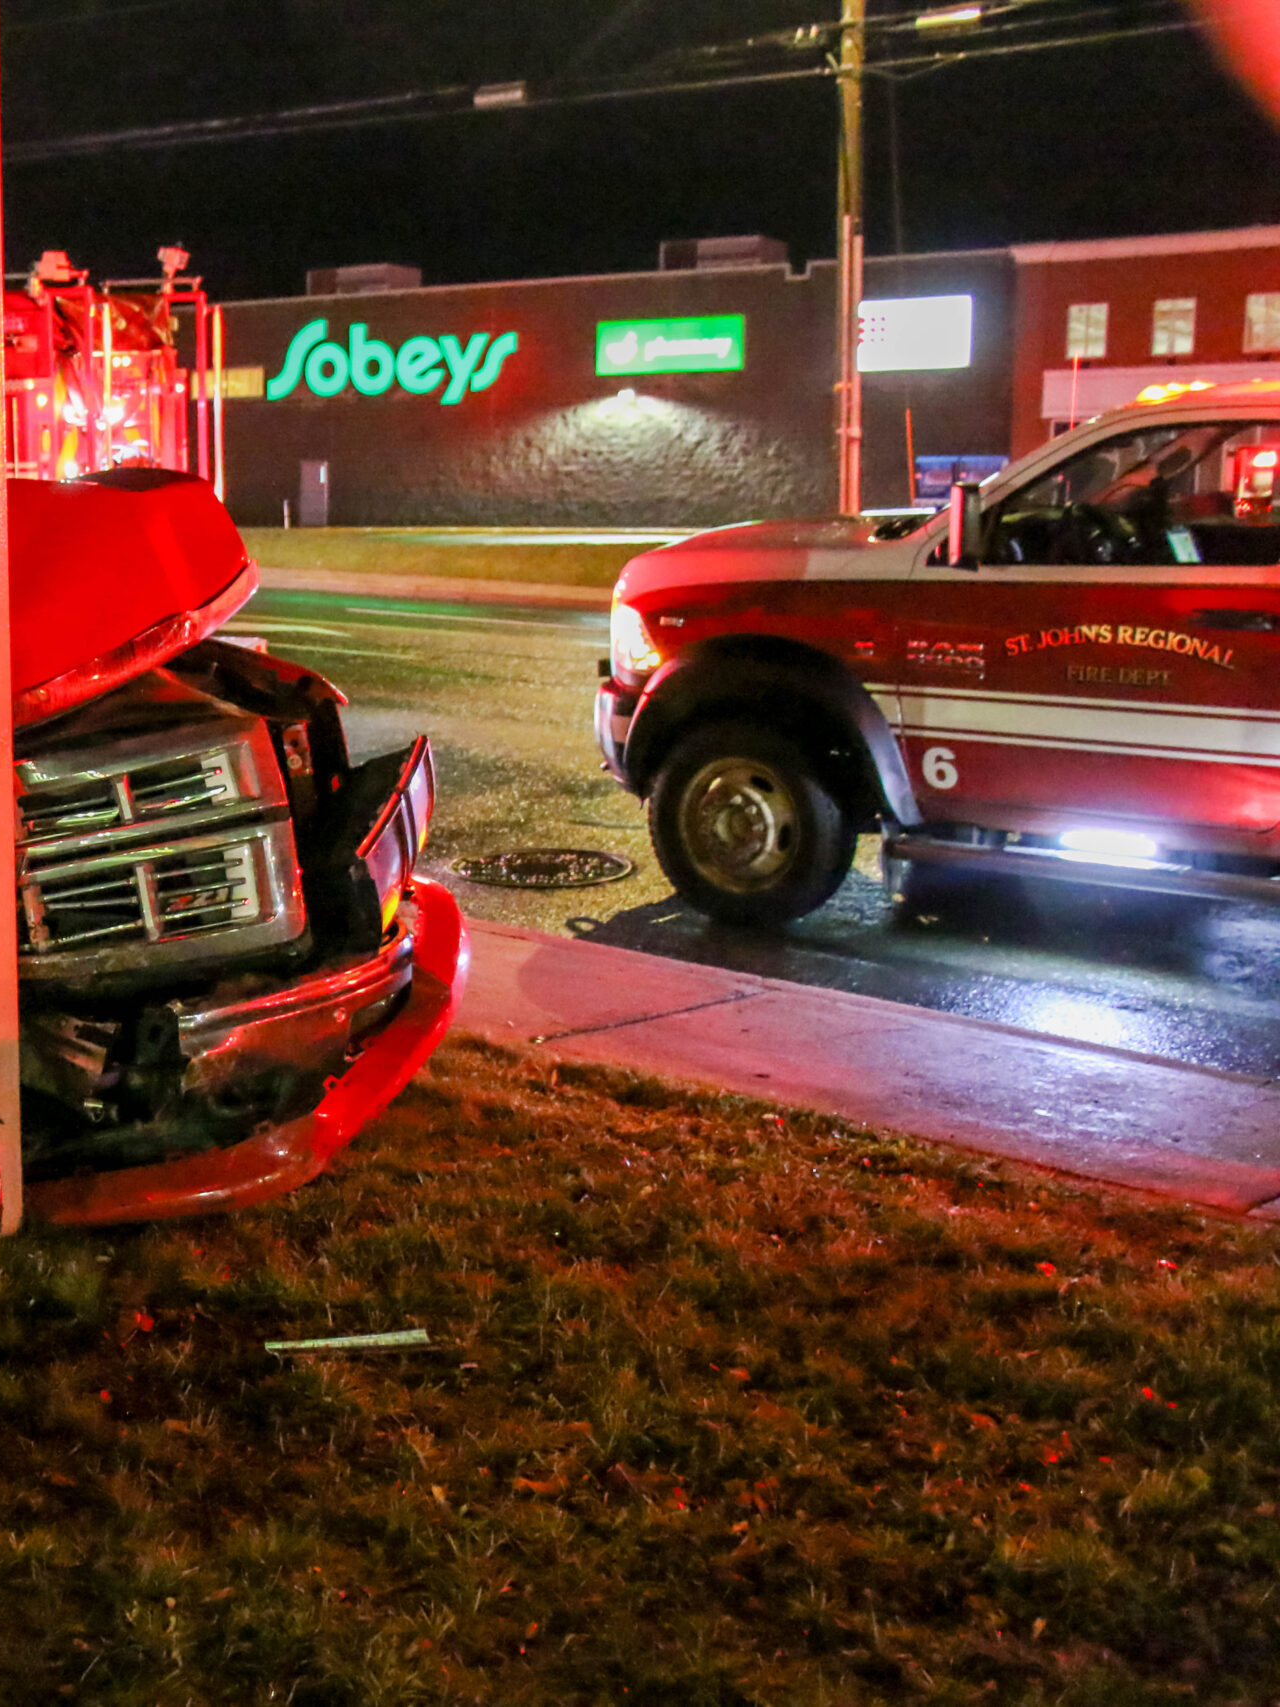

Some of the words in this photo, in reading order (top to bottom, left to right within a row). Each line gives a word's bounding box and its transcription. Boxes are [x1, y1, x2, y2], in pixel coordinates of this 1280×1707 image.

[267, 318, 517, 405] Sobeys
[1117, 625, 1234, 669] REGIONAL
[1067, 664, 1113, 682] FIRE
[922, 746, 959, 789] 6
